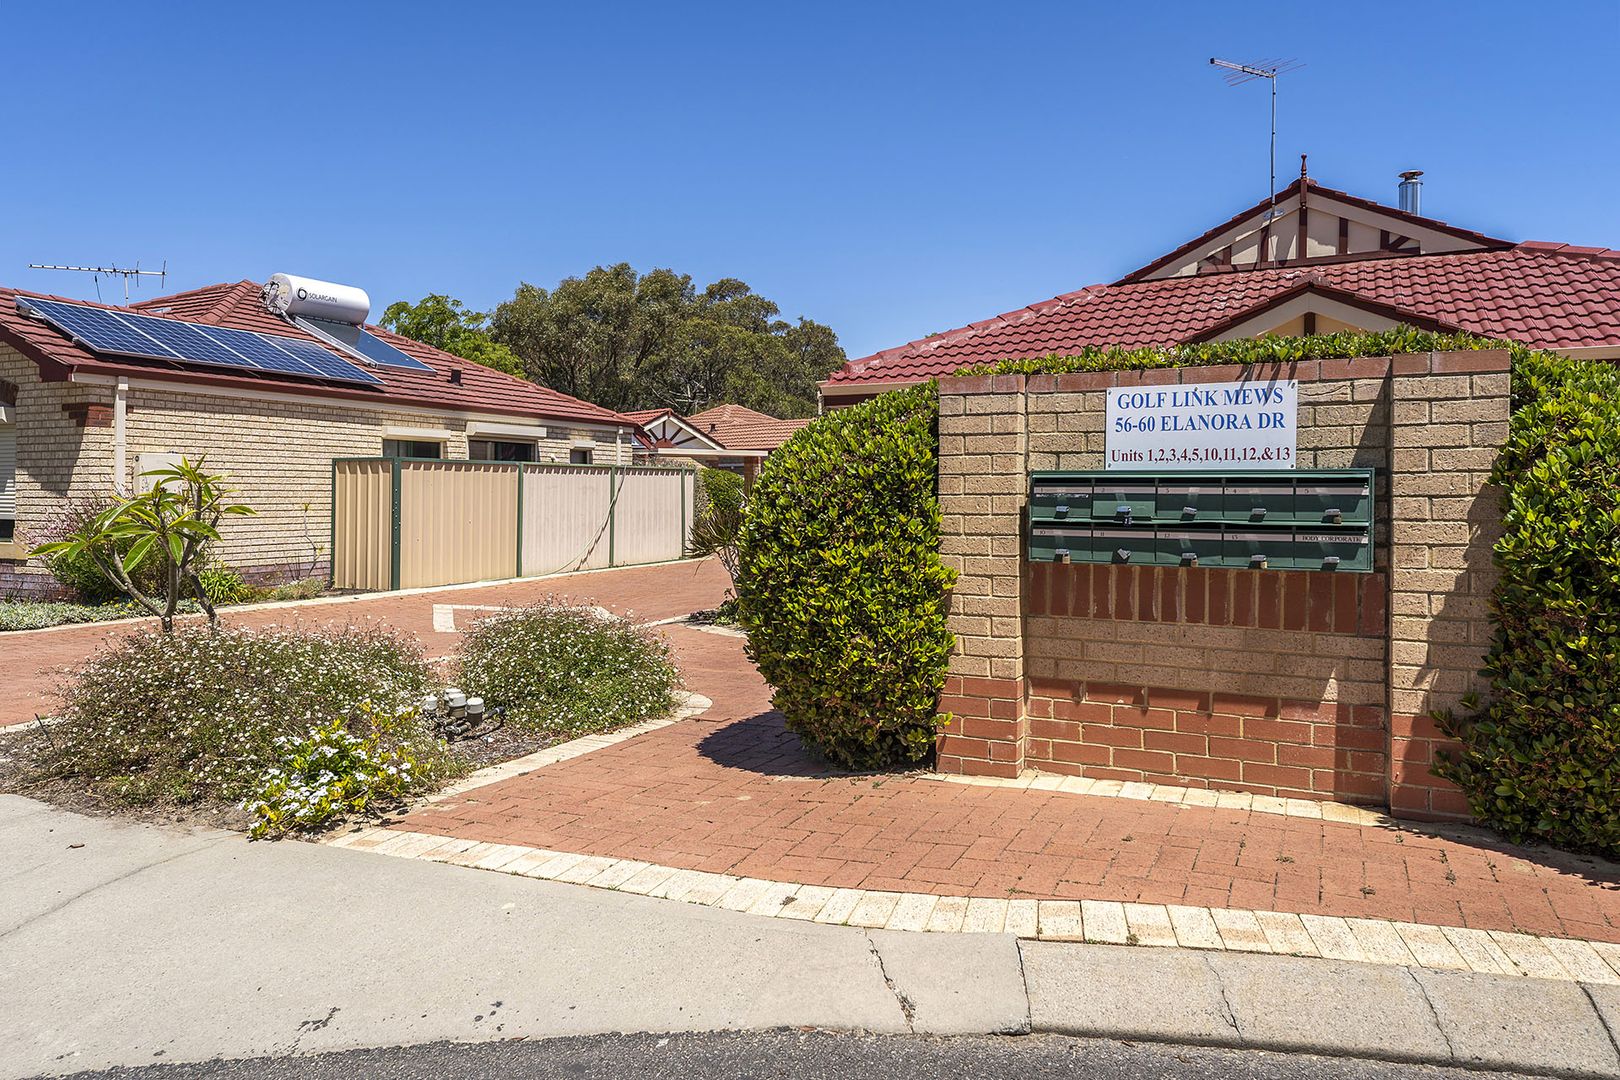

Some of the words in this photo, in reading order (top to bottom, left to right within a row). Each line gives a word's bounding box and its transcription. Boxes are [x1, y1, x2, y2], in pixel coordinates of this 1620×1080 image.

[308, 292, 338, 303] SOLARGAIN
[1117, 392, 1167, 409] GOLF
[1171, 388, 1218, 407] LINK
[1223, 387, 1284, 406] MEWS
[1115, 416, 1156, 433] 56-60
[1160, 413, 1256, 432] ELANORA
[1257, 412, 1286, 429] DR
[1111, 449, 1144, 462] Units
[1148, 446, 1291, 464] 1,2,3,4,5,10,11,12,&13
